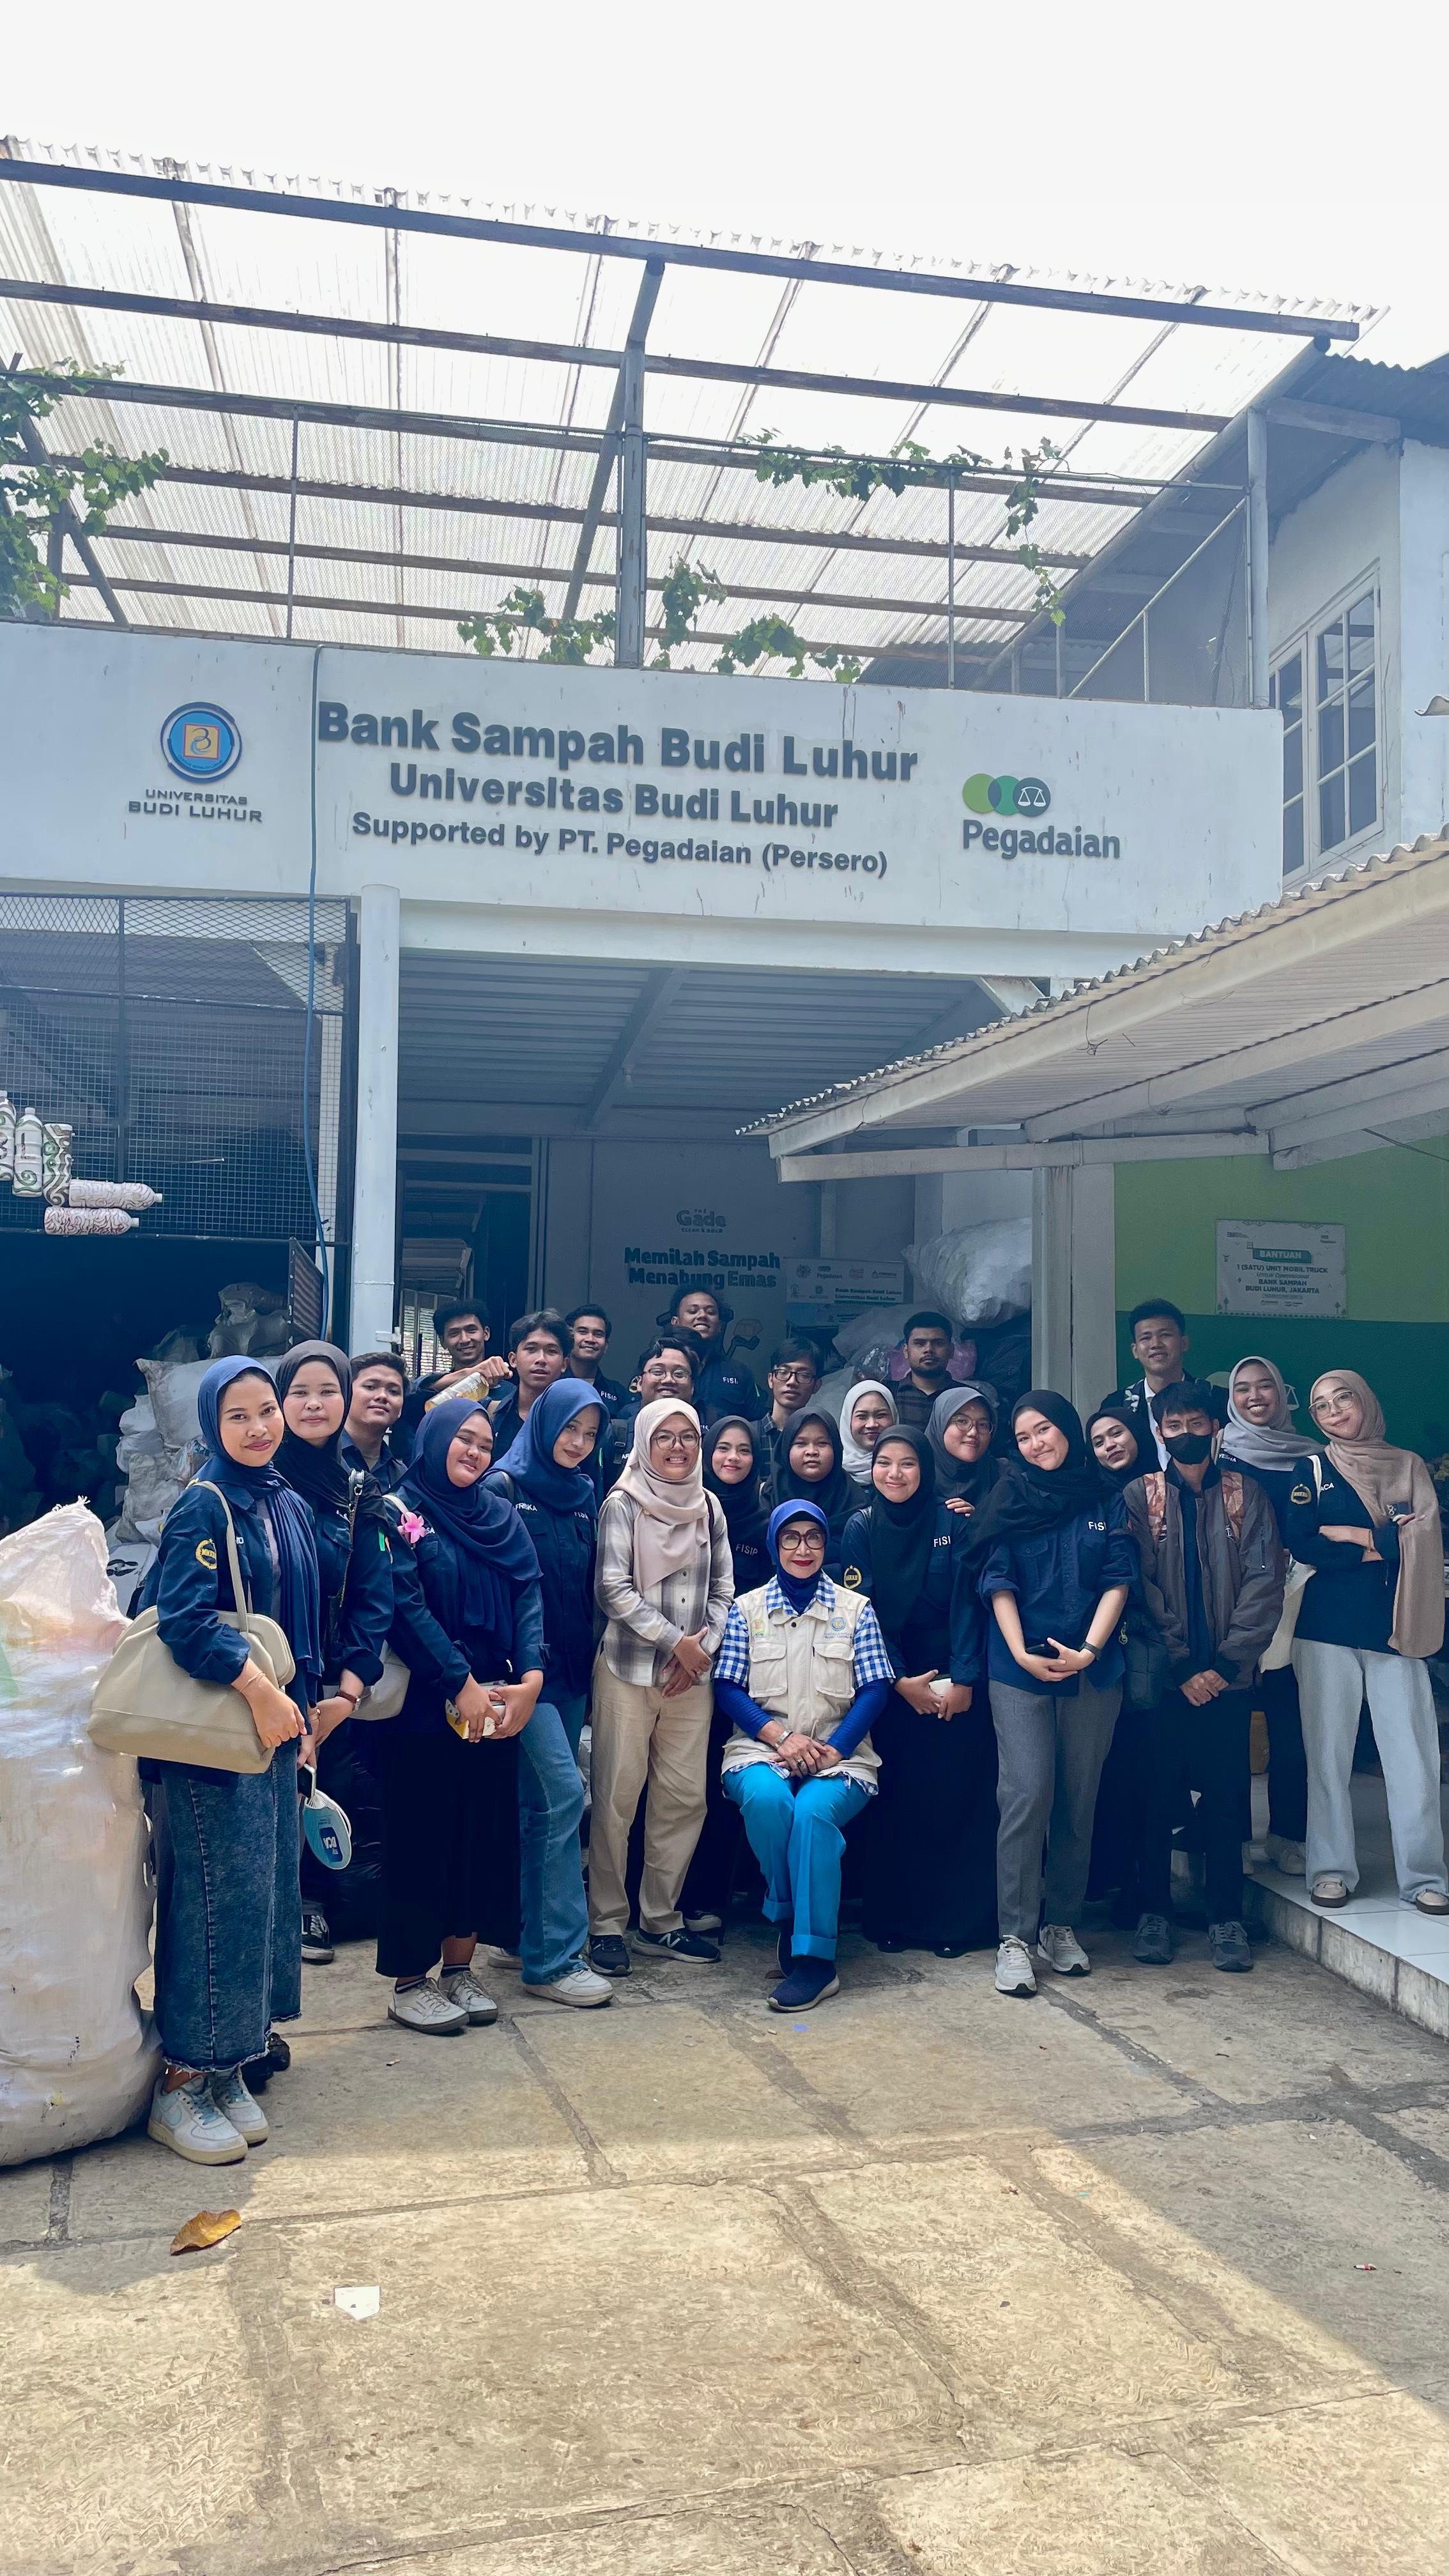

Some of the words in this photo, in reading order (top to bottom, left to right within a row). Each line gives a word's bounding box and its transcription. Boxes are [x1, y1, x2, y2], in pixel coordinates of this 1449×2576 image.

[318, 702, 440, 751] Bank
[451, 712, 643, 770] Sampah
[661, 727, 765, 773] Budi
[783, 735, 918, 781] Luhur
[145, 788, 248, 805] UNIVERSITAS
[389, 763, 624, 813] Universitas
[635, 783, 719, 820] Budi
[731, 791, 838, 827] Luhur
[128, 800, 180, 816] BUDI
[189, 806, 263, 823] LUHUR
[352, 811, 505, 846] Supported
[515, 824, 549, 855] by
[559, 830, 598, 854] PT.
[607, 832, 751, 865] Pegadaian
[762, 842, 888, 878] (Persero)
[963, 819, 1120, 860] Pegadaian
[677, 1210, 726, 1227] Gade
[624, 1247, 705, 1266] Memilah
[707, 1250, 781, 1271] Sampah
[629, 1268, 725, 1290] Menabung
[728, 1271, 777, 1287] Emas
[735, 1543, 758, 1556] FISIP
